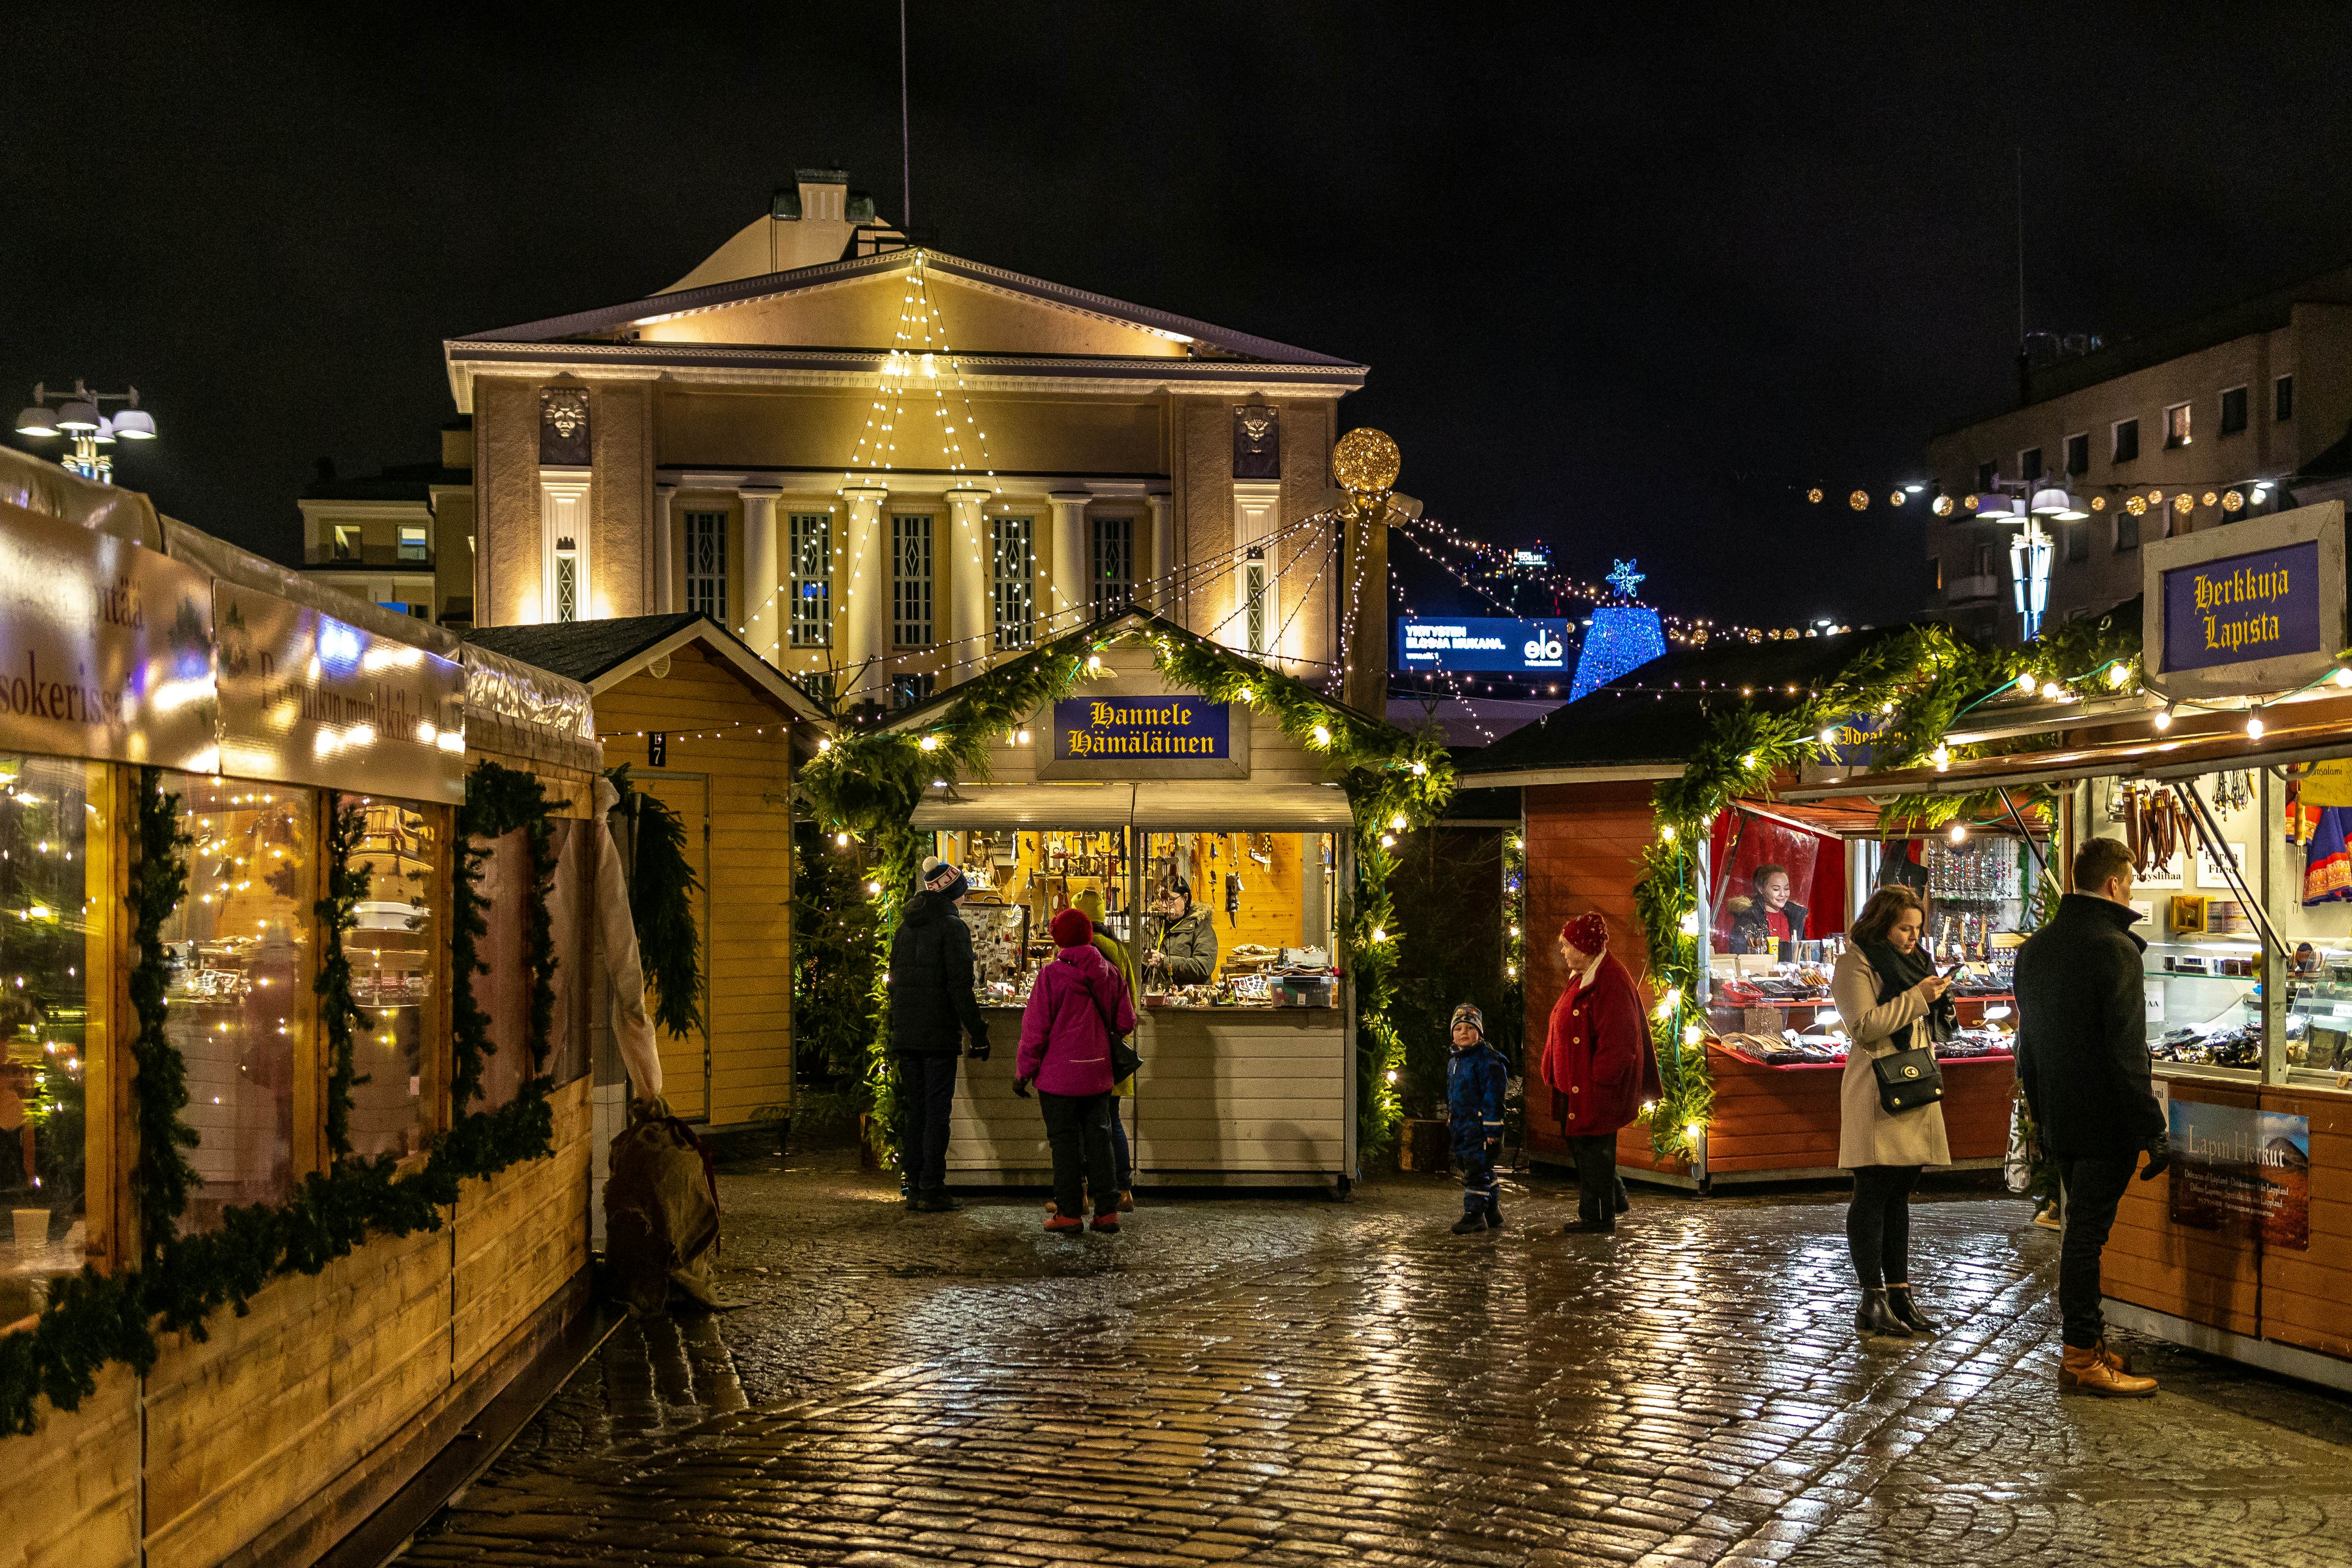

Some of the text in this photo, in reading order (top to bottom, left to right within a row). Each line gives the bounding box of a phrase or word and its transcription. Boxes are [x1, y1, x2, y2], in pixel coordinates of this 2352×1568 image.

[2194, 562, 2289, 615] Herkkuja
[1524, 629, 1563, 659] elo
[2203, 611, 2280, 652] Lapista
[1090, 702, 1192, 729] Hannele
[654, 747, 661, 764] 7
[1068, 730, 1215, 757] Hämäläinen
[2189, 1124, 2285, 1168] Lapin Herkut
[2260, 1195, 2283, 1209] Lappland
[2267, 1183, 2289, 1197] Lappland
